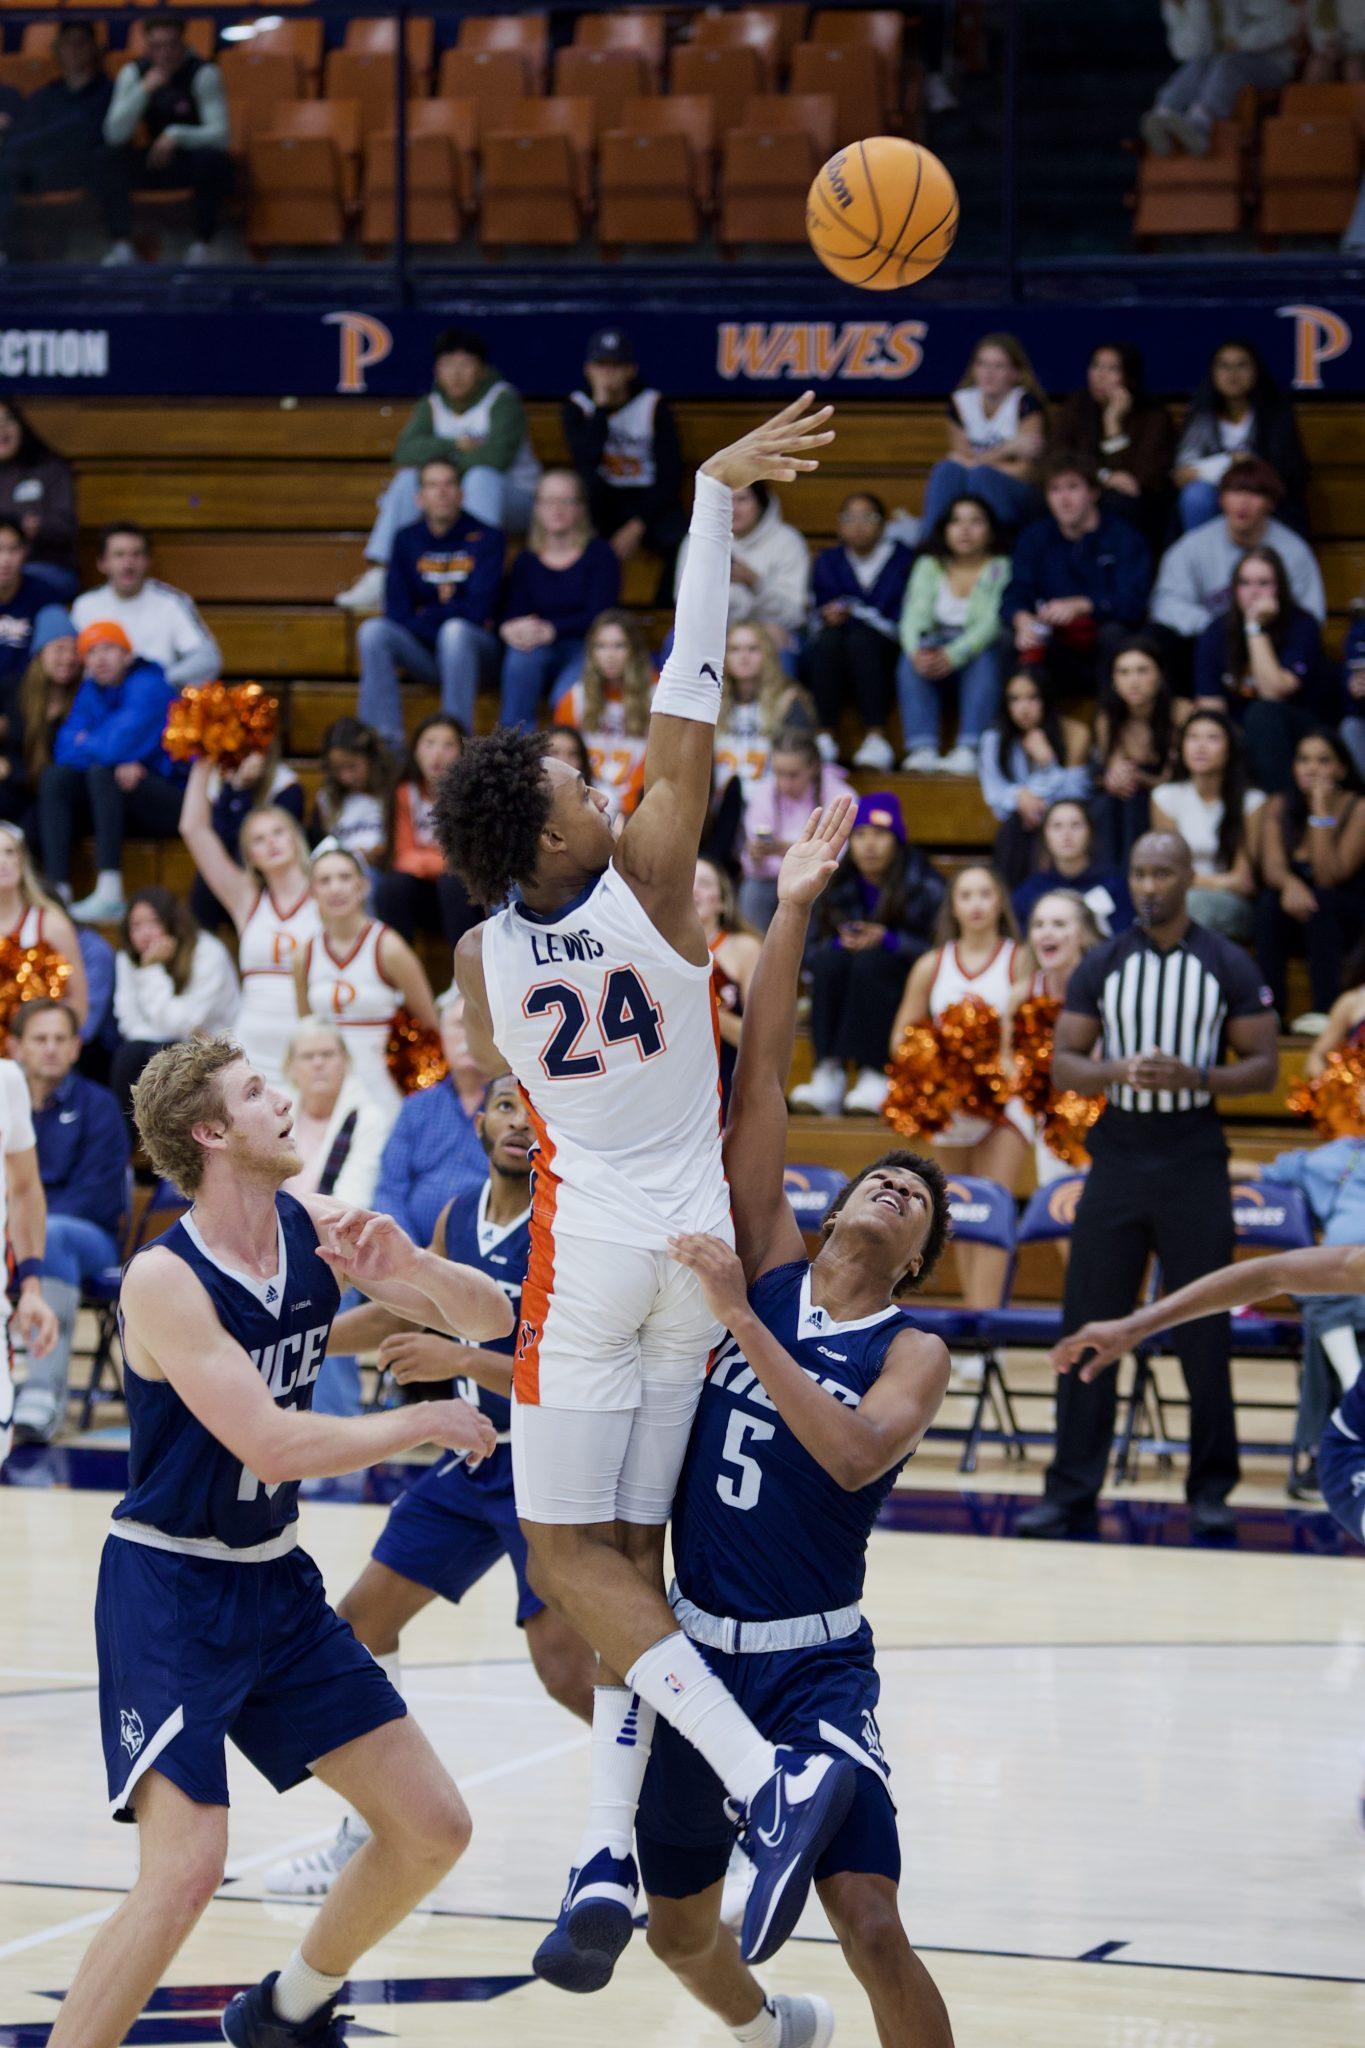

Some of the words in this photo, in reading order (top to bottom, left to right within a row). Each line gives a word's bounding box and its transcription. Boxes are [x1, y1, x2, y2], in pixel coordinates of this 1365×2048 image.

[0, 328, 108, 378] CTION
[320, 311, 394, 394] P
[716, 319, 929, 381] WAVES
[1275, 304, 1352, 390] P
[531, 928, 604, 966] LEWIS
[521, 962, 668, 1081] 24
[249, 1323, 329, 1398] ICE
[715, 1408, 776, 1511] 5
